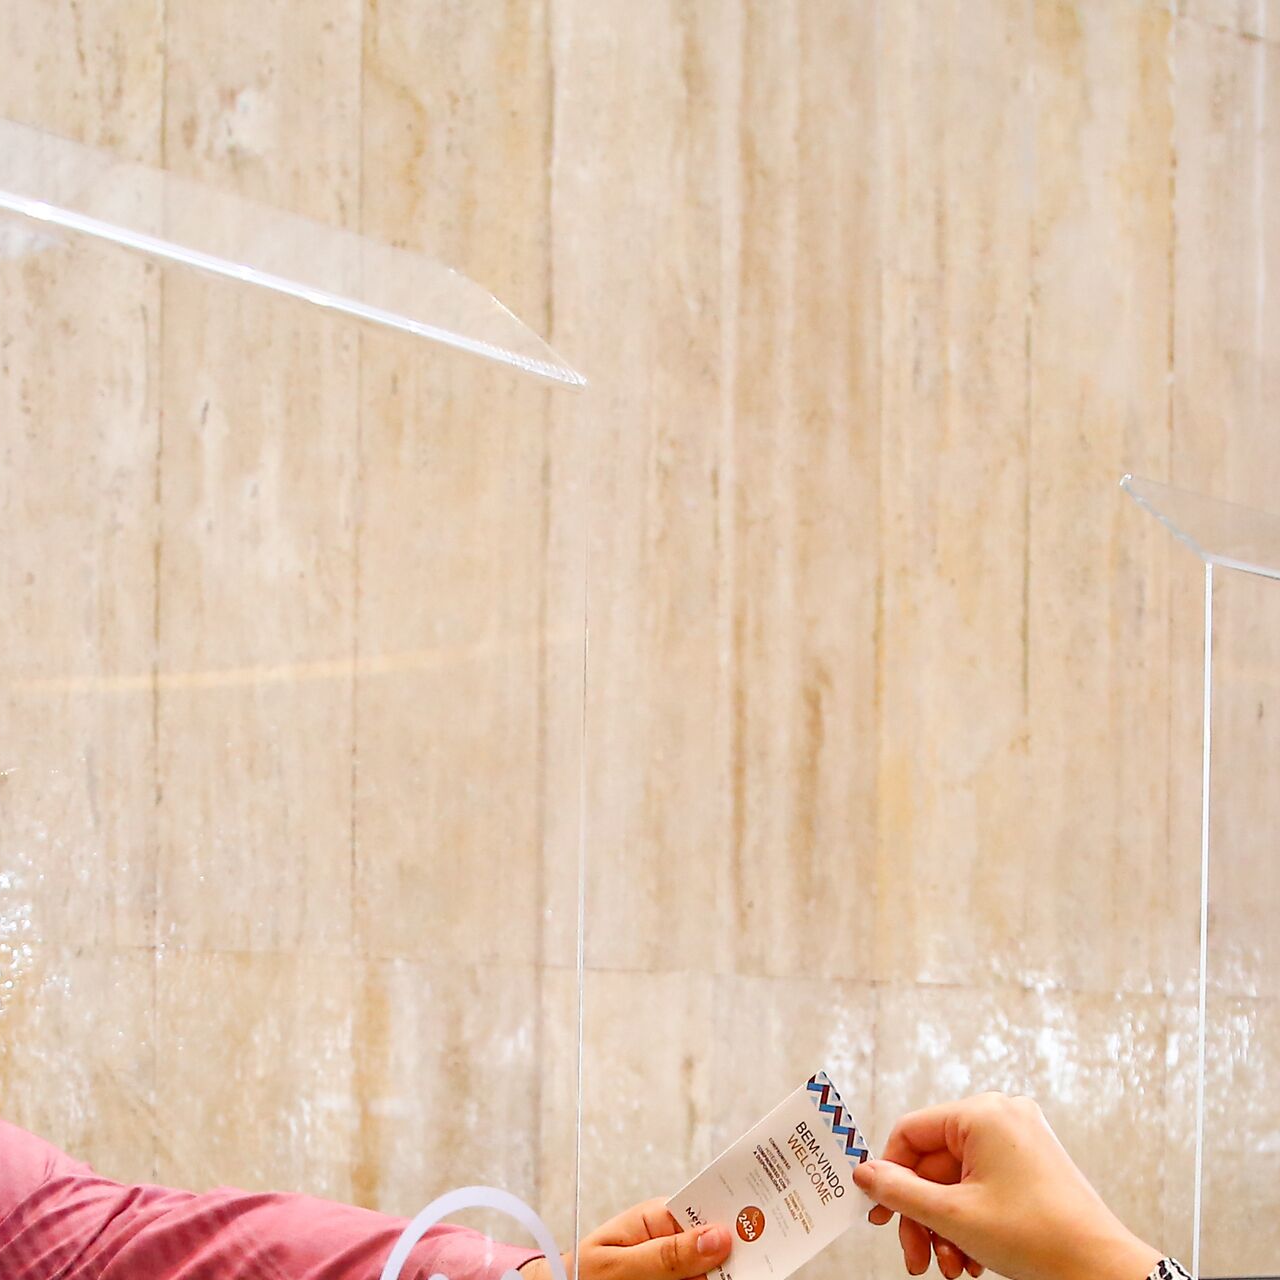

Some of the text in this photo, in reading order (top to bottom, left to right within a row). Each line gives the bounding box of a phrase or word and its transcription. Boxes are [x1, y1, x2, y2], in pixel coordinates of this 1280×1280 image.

[787, 1133, 833, 1206] WELCOME
[795, 1121, 845, 1198] BEM-VINDO
[738, 1213, 756, 1240] 2424
